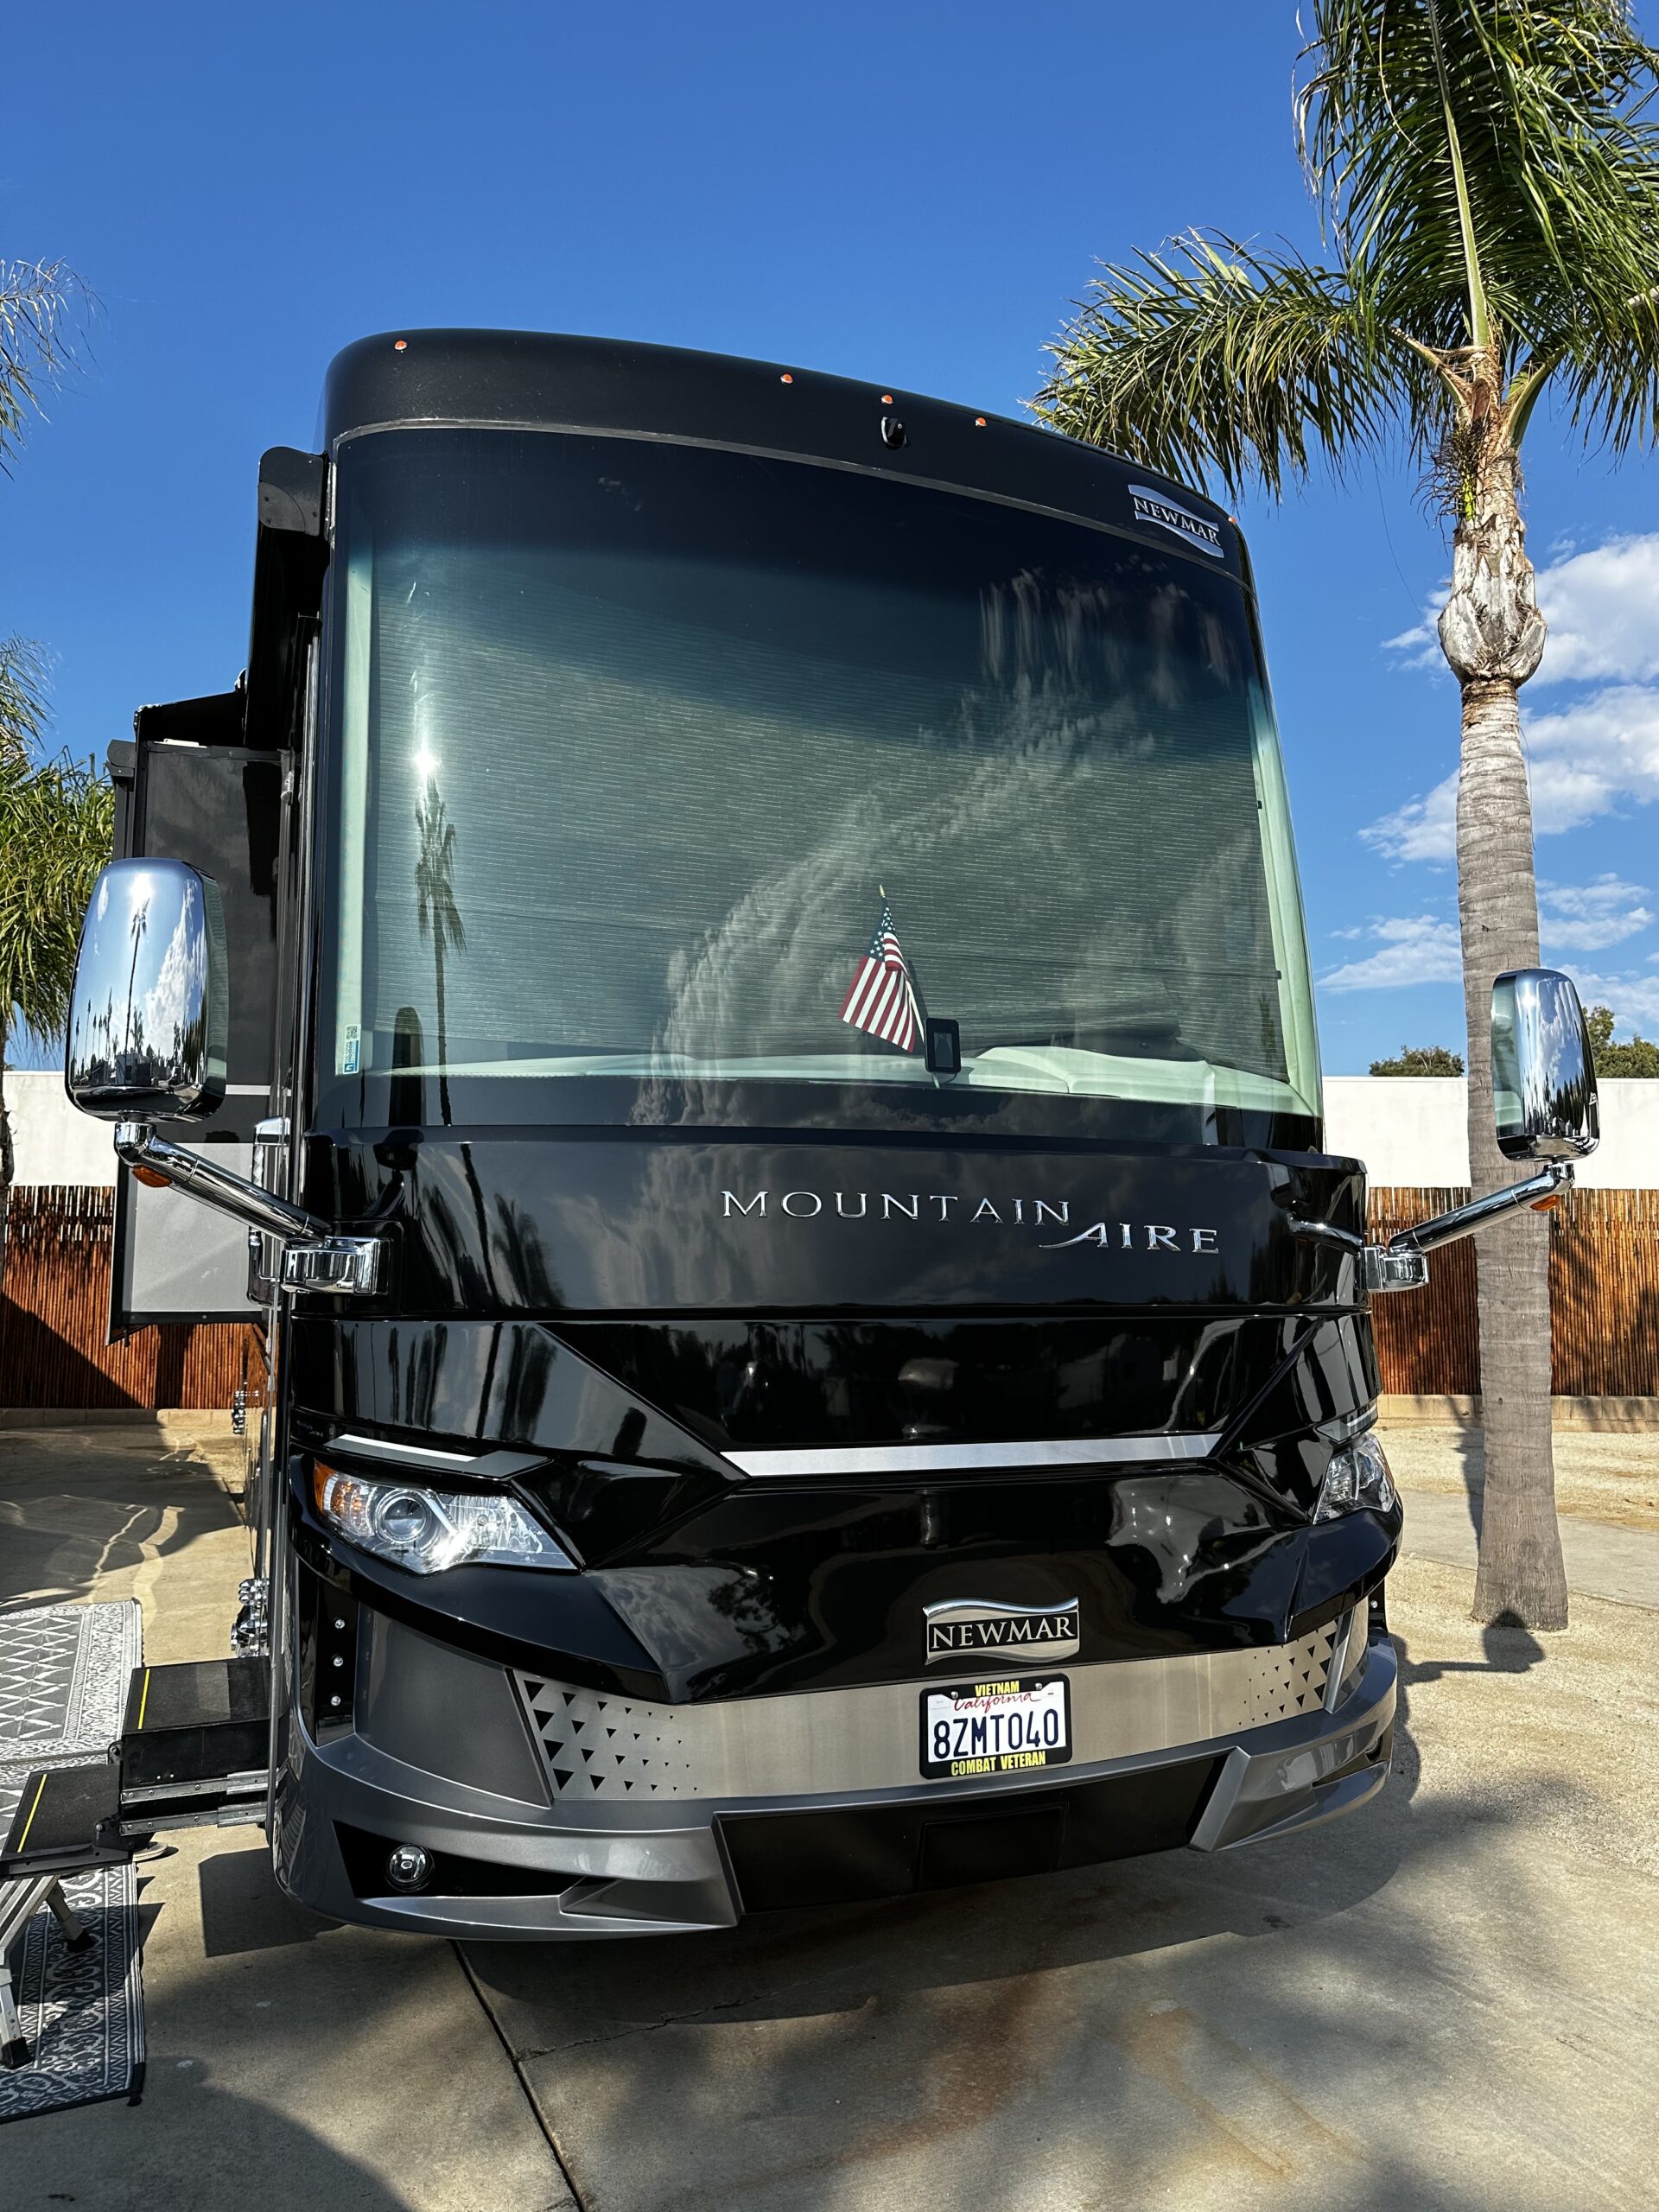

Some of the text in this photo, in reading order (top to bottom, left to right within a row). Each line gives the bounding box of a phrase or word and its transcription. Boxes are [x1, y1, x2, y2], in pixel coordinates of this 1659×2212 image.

[1133, 497, 1221, 546] NEWMAR
[721, 1191, 1220, 1254] MOUNTAIN AIRE
[931, 1616, 1076, 1649] NEWMAR
[954, 1691, 1041, 1713] California
[975, 1681, 1020, 1697] VIETNAM
[933, 1708, 1059, 1759] 8ZMT040
[951, 1751, 1046, 1777] COMBAT VETERAN
